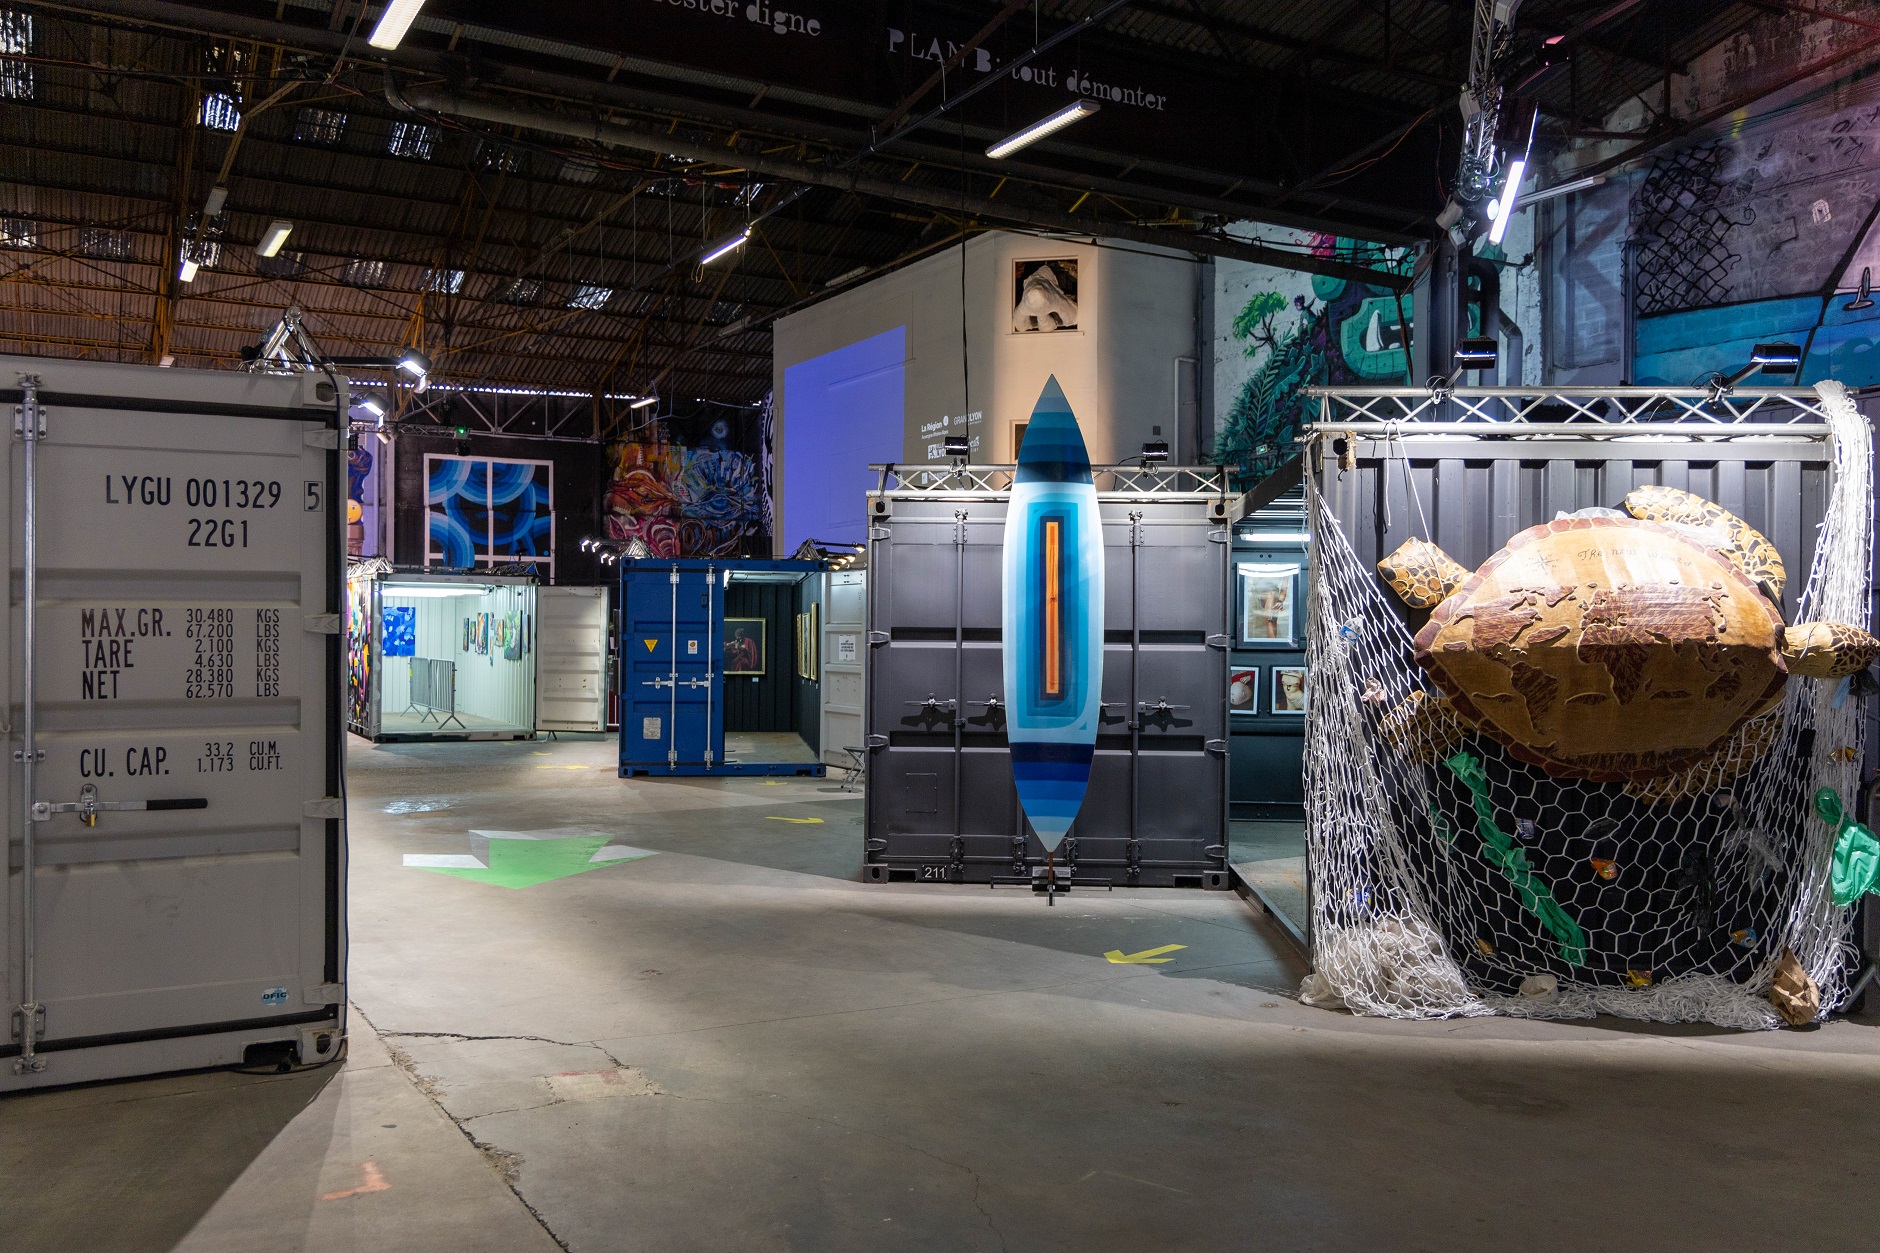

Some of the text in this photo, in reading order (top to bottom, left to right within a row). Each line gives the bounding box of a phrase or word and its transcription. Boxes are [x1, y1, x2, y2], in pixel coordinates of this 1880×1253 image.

[746, 0, 821, 36] digne
[887, 27, 966, 68] PLAN
[1012, 59, 1057, 88] tout
[1066, 69, 1167, 111] démonter
[927, 421, 942, 431] Région
[106, 474, 321, 510] LYGU 001329 5
[187, 518, 248, 548] 22G1
[81, 608, 172, 638] MAX.GR.
[256, 608, 280, 623] KGS
[186, 623, 280, 639] 67,200 LBS
[82, 638, 280, 669] TARE 2,100 KGS
[194, 653, 280, 669] 4,630 LBS
[82, 668, 280, 699] NET 28,380 KGS
[186, 682, 280, 699] 62,570 LBS
[80, 748, 114, 778] CU.
[126, 746, 170, 776] CAP.
[205, 742, 234, 757] 33.2
[197, 757, 234, 773] 1,173
[924, 866, 946, 879] 211
